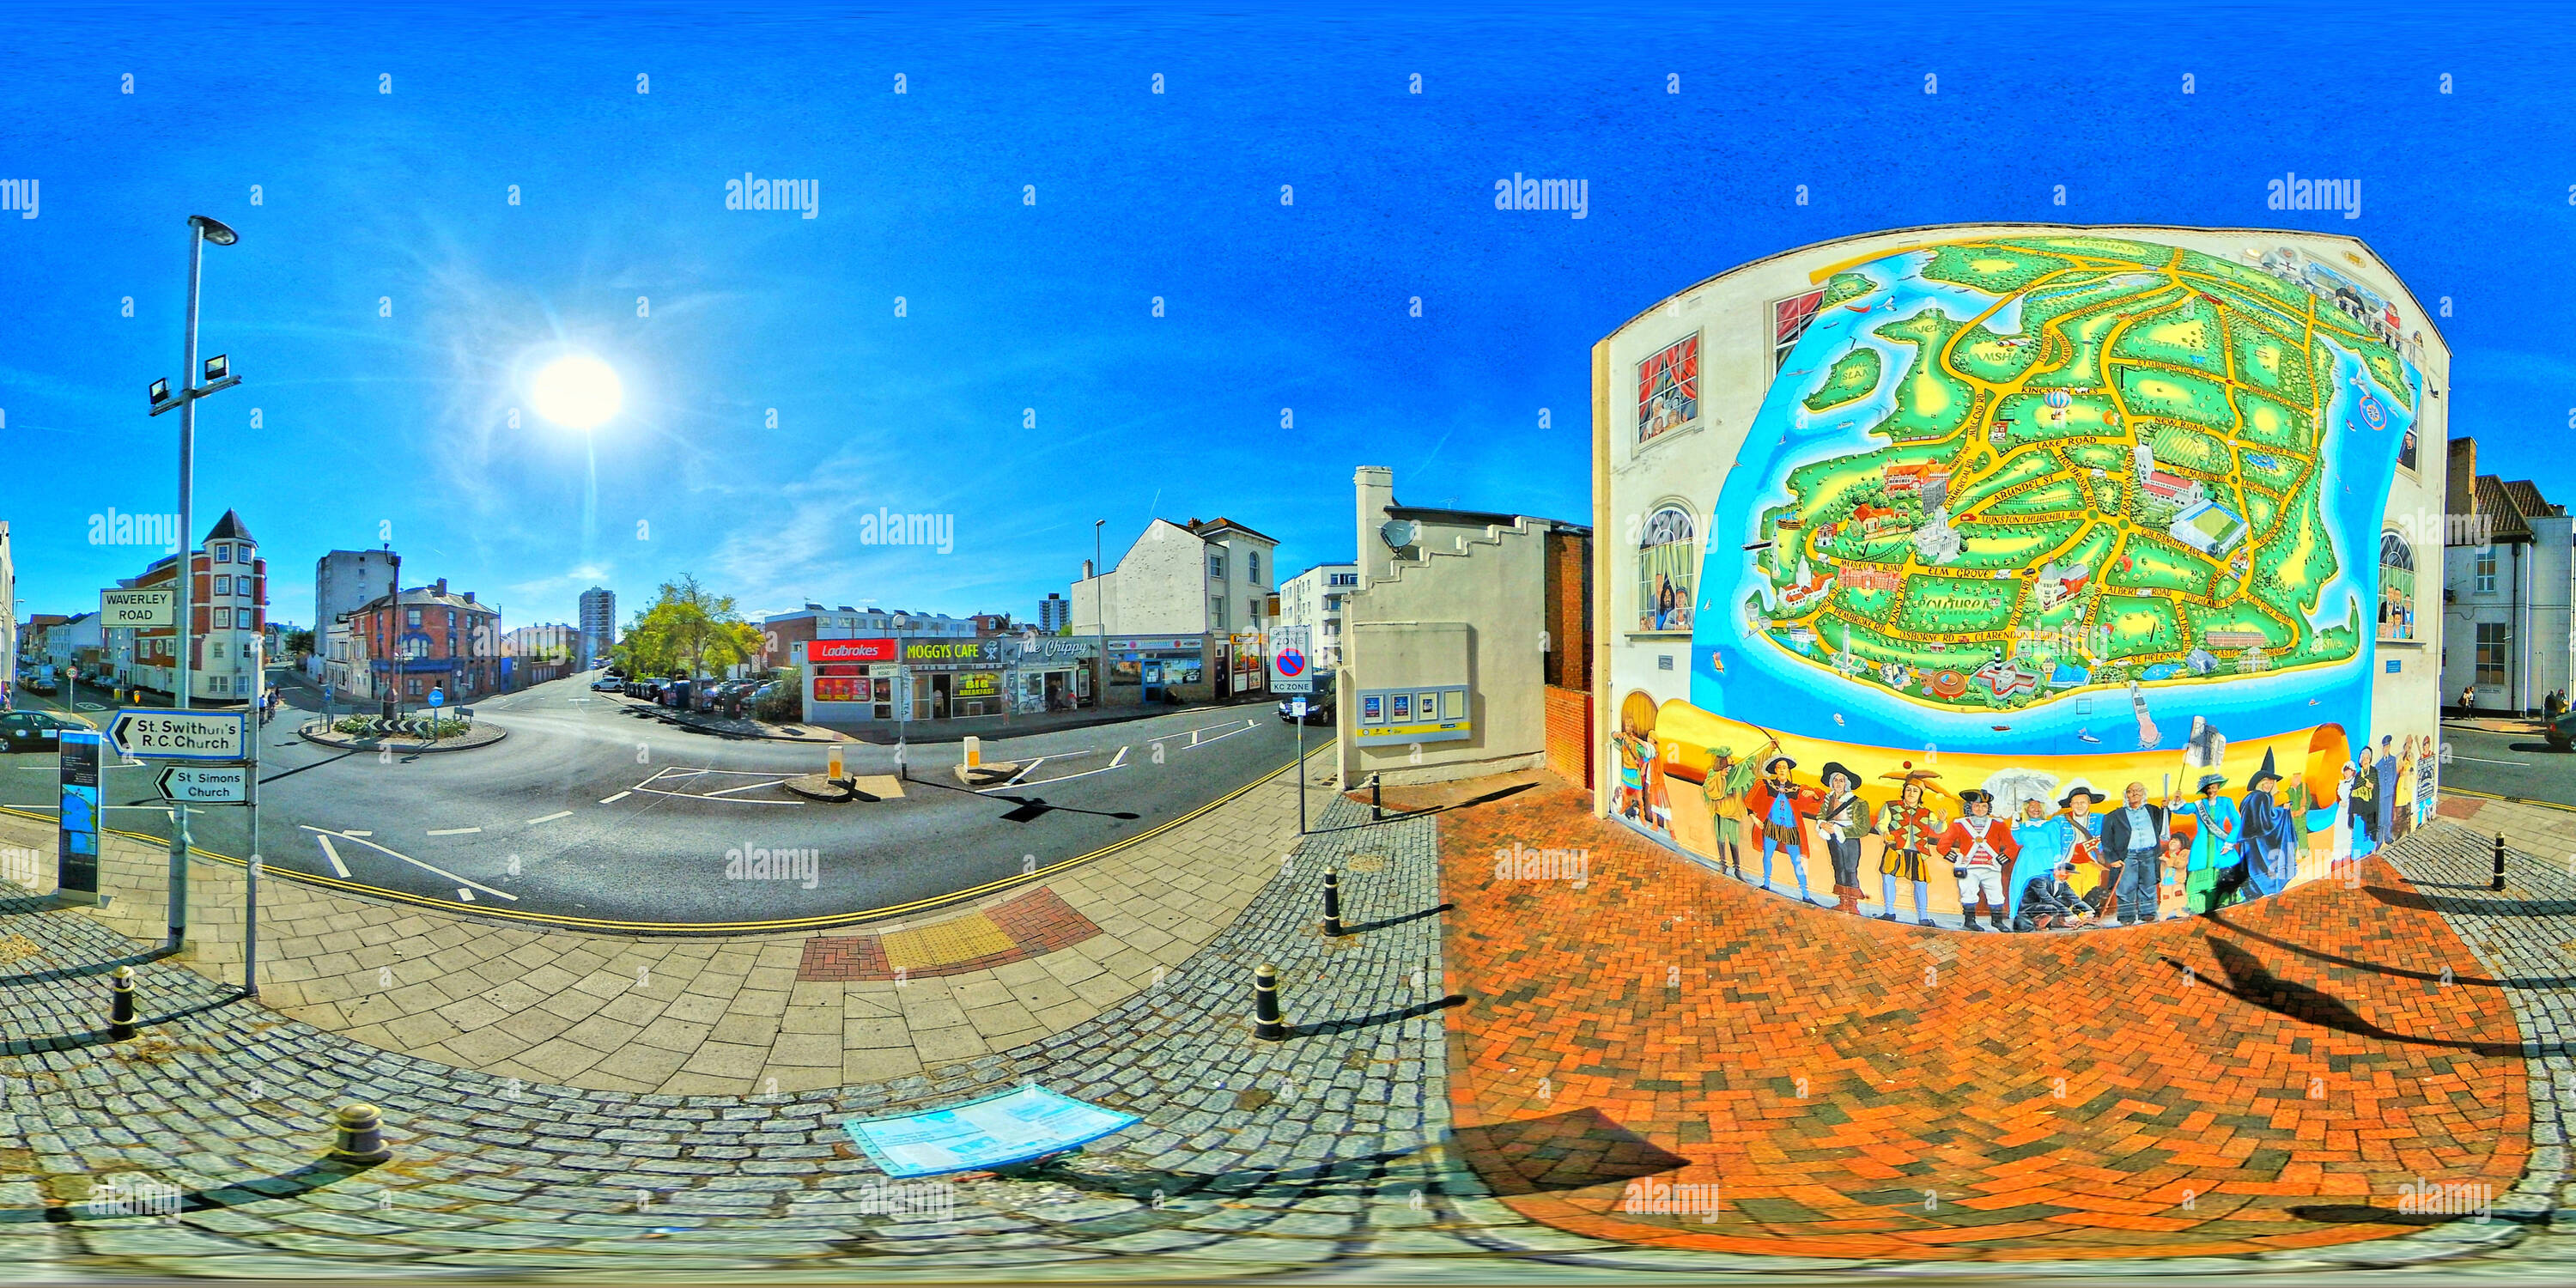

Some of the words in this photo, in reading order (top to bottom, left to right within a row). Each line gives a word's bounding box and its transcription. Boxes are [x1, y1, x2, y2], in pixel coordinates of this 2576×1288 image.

[2157, 305, 2176, 313] ROAD
[1977, 393, 1985, 404] RD
[1972, 404, 1984, 420] END
[2154, 417, 2177, 426] NEW
[2181, 422, 2205, 433] ROAD
[2036, 440, 2063, 450] LAKE
[2068, 436, 2097, 445] ROAD
[2125, 449, 2136, 471] ROAD
[1943, 468, 1972, 511] COMMERCIAL
[1967, 459, 1974, 467] RD
[2057, 453, 2090, 494] HOLBROOK
[2085, 495, 2095, 507] RD
[1993, 480, 2040, 503] ARUNDEL
[2044, 475, 2055, 483] ST
[2121, 476, 2133, 517] FRATTON
[1983, 515, 2021, 524] WINSTON
[2022, 513, 2066, 523] CHURCHILL
[2257, 524, 2280, 545] VELDER
[2141, 528, 2186, 551] GOLDSMITH
[2187, 547, 2202, 558] AVE
[1839, 560, 1877, 571] MUSEUM
[1882, 564, 1904, 573] ROAD
[1929, 567, 1949, 576] ELM
[1957, 568, 1990, 579] GROVE
[2219, 568, 2226, 576] RD
[2107, 586, 2137, 596] ALBERT
[2152, 588, 2172, 597] ROAD
[106, 594, 167, 605] WAVERLEY
[1818, 597, 1833, 615] HIGH
[1888, 597, 1903, 627] KINGS
[1898, 578, 1907, 594] TER
[2010, 592, 2027, 628] VICTORIA
[2022, 580, 2032, 591] RD
[2184, 592, 2223, 609] HIGHLAND
[2224, 591, 2241, 605] ROAD
[118, 610, 153, 620] ROAD
[1833, 607, 1874, 629] PEMBROKE
[1874, 623, 1886, 634] RD
[2275, 613, 2291, 624] ROAD
[1277, 637, 1304, 646] ZONE
[1899, 631, 1940, 641] OSBORNE
[1975, 631, 2029, 642] CLARENDON
[2033, 630, 2057, 641] ROAD
[822, 645, 878, 657] Ladbrokes
[907, 644, 951, 659] MOGGYS
[954, 644, 979, 659] CAFE
[1016, 640, 1042, 659] The
[1045, 639, 1089, 657] Chippy
[2184, 639, 2192, 651] RD
[2144, 653, 2178, 662] HELENS
[966, 679, 989, 690] BIG
[137, 720, 158, 733] St.
[174, 736, 229, 750] Church
[178, 773, 191, 783] St
[198, 774, 240, 783] Simons
[188, 787, 229, 797] Church
